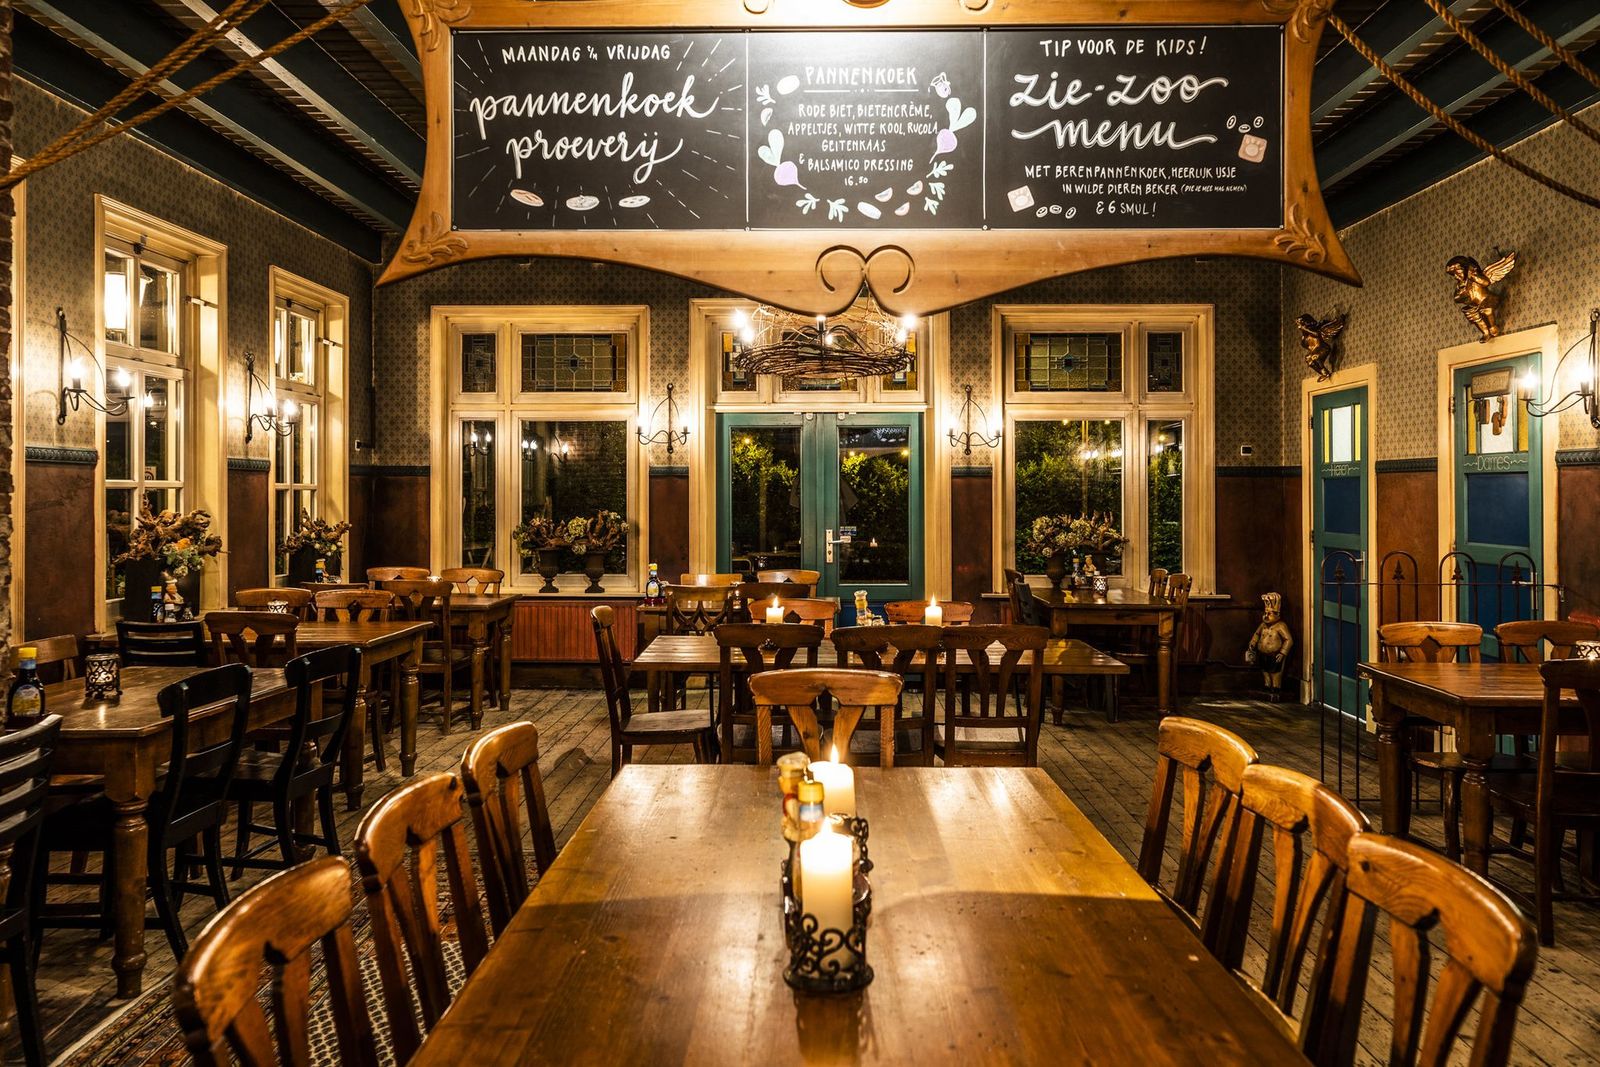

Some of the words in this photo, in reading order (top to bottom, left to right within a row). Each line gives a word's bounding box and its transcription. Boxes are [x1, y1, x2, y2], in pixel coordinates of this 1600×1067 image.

[501, 45, 581, 65] MAANDAG
[606, 43, 671, 61] VRIJDAG
[1039, 39, 1072, 58] TIP
[1077, 39, 1117, 56] VOOR
[1125, 39, 1145, 56] DE
[1156, 35, 1208, 57] KIDS!
[804, 66, 918, 86] PANNENKOEK
[469, 71, 720, 141] pannenkoek
[798, 103, 827, 118] RODE
[829, 104, 856, 120] BIET,
[857, 101, 933, 120] BIETENCRÈME,
[787, 121, 842, 138] APPELTJES,
[844, 122, 876, 135] WITTE
[879, 122, 906, 136] KOOL,
[1011, 118, 1218, 152] menu
[821, 138, 886, 153] GEITENKAAS
[505, 129, 684, 185] proeverij
[807, 157, 860, 173] BALSAMICO
[863, 157, 914, 172] DRESSING
[1024, 165, 1051, 179] MET
[1171, 165, 1213, 179] HEERLIJK
[1062, 183, 1073, 195] IN
[1074, 182, 1105, 196] WILDE
[1107, 182, 1142, 196] DIEREN
[1145, 183, 1179, 196] BEKER
[1120, 202, 1158, 218] SMUL!
[1477, 455, 1511, 471] Dames
